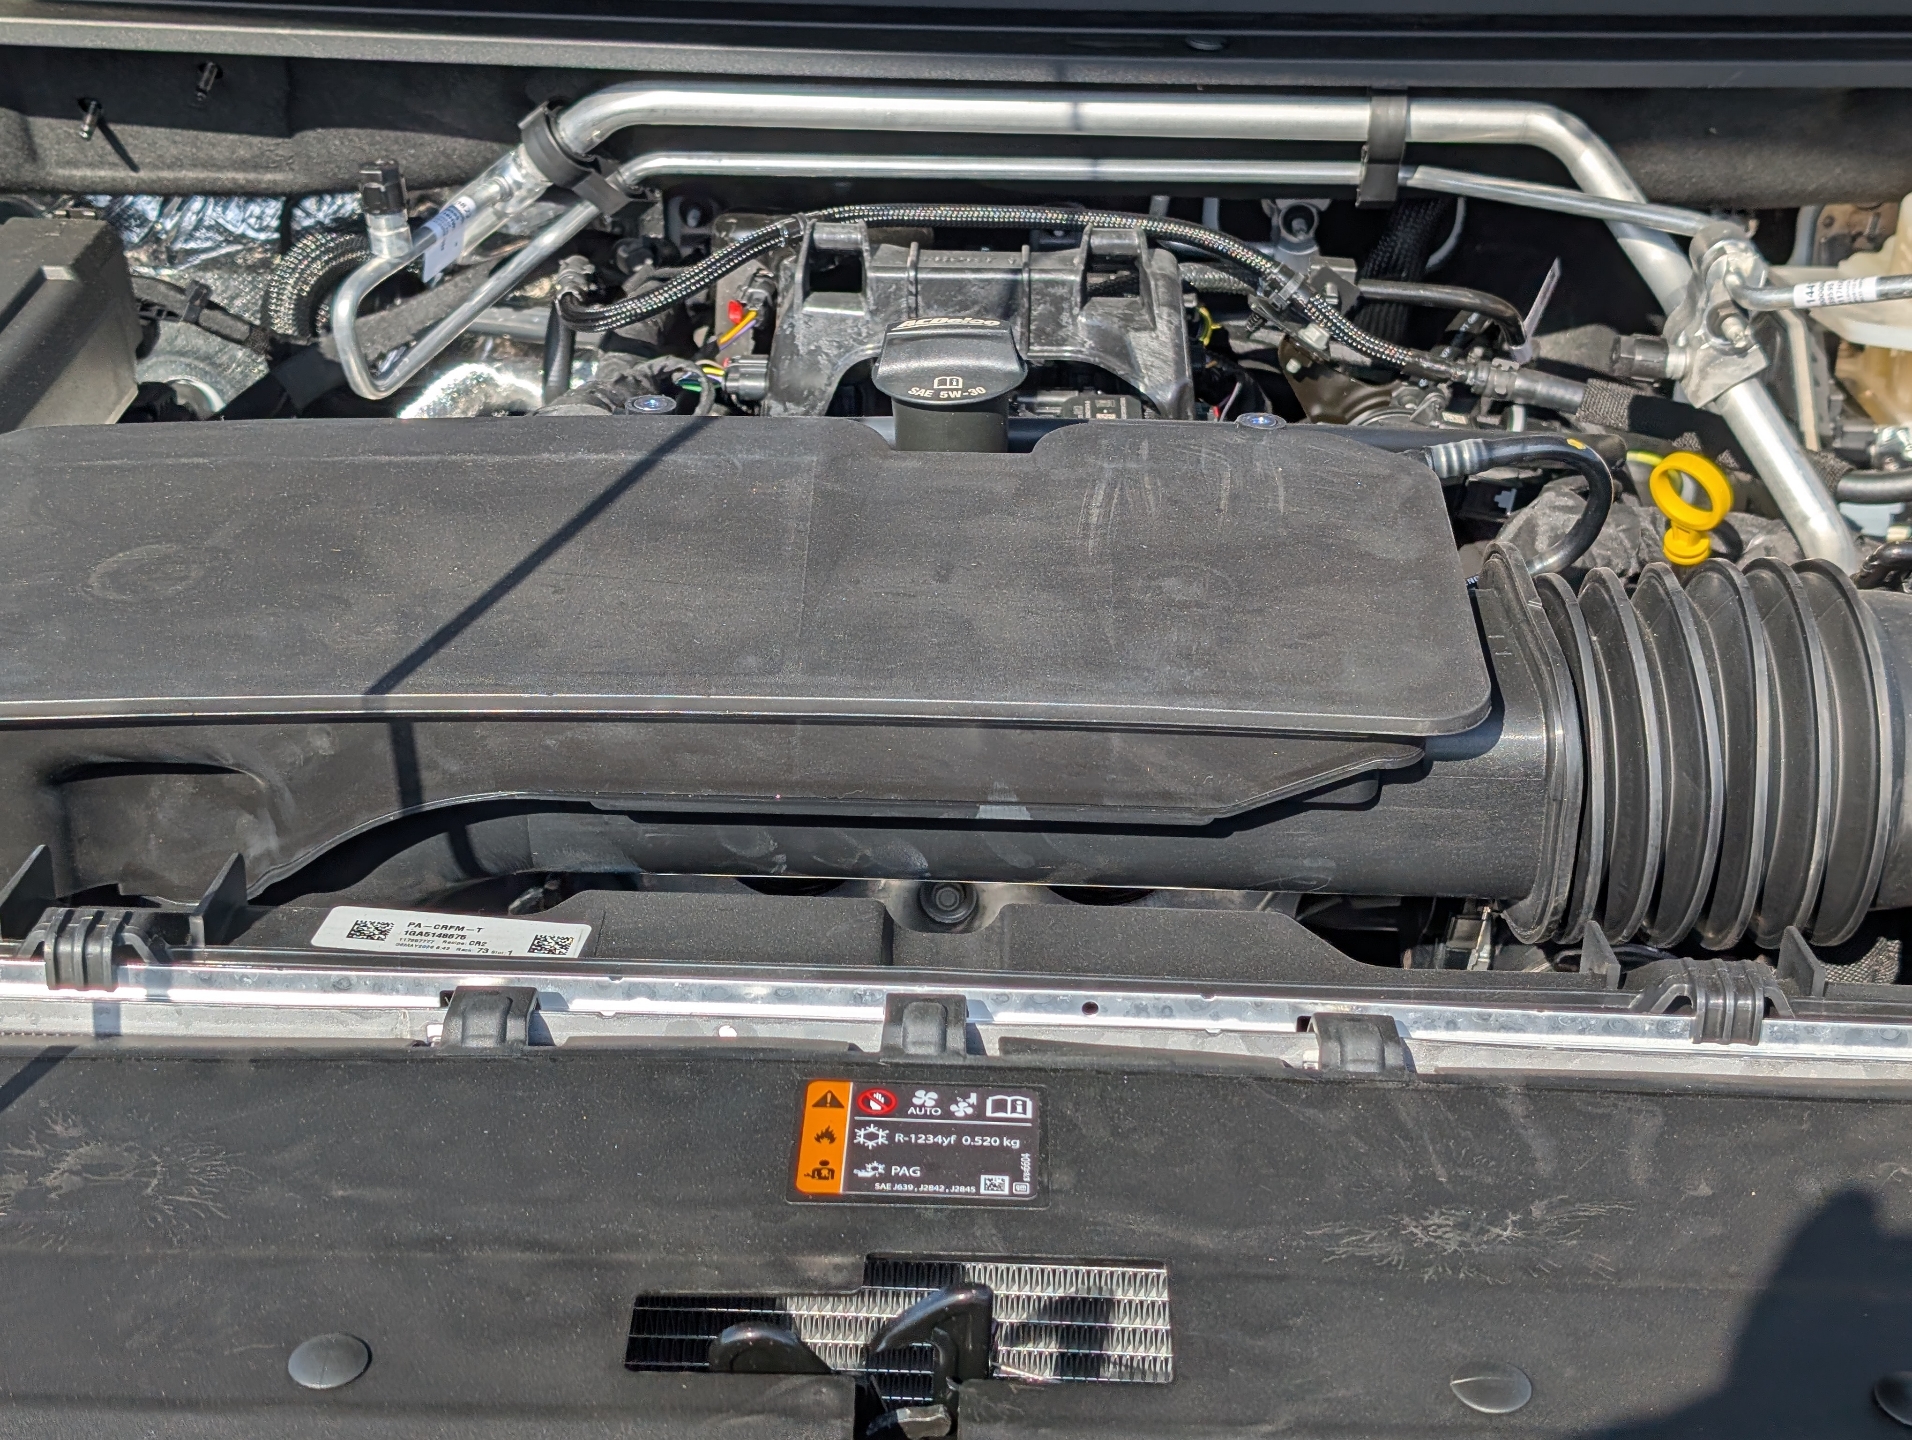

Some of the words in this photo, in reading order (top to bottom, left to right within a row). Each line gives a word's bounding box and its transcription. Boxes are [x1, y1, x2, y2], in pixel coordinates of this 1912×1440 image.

[891, 317, 1001, 331] ACDelco
[907, 386, 934, 398] SAE
[939, 386, 987, 399] 5W-30
[907, 1106, 942, 1116] AUTO
[895, 1133, 957, 1147] R-1234yf
[962, 1135, 1000, 1147] 0.520
[1003, 1136, 1021, 1149] kg
[891, 1165, 921, 1177] PAG
[874, 1182, 891, 1191] SAE
[950, 1185, 976, 1193] J2845
